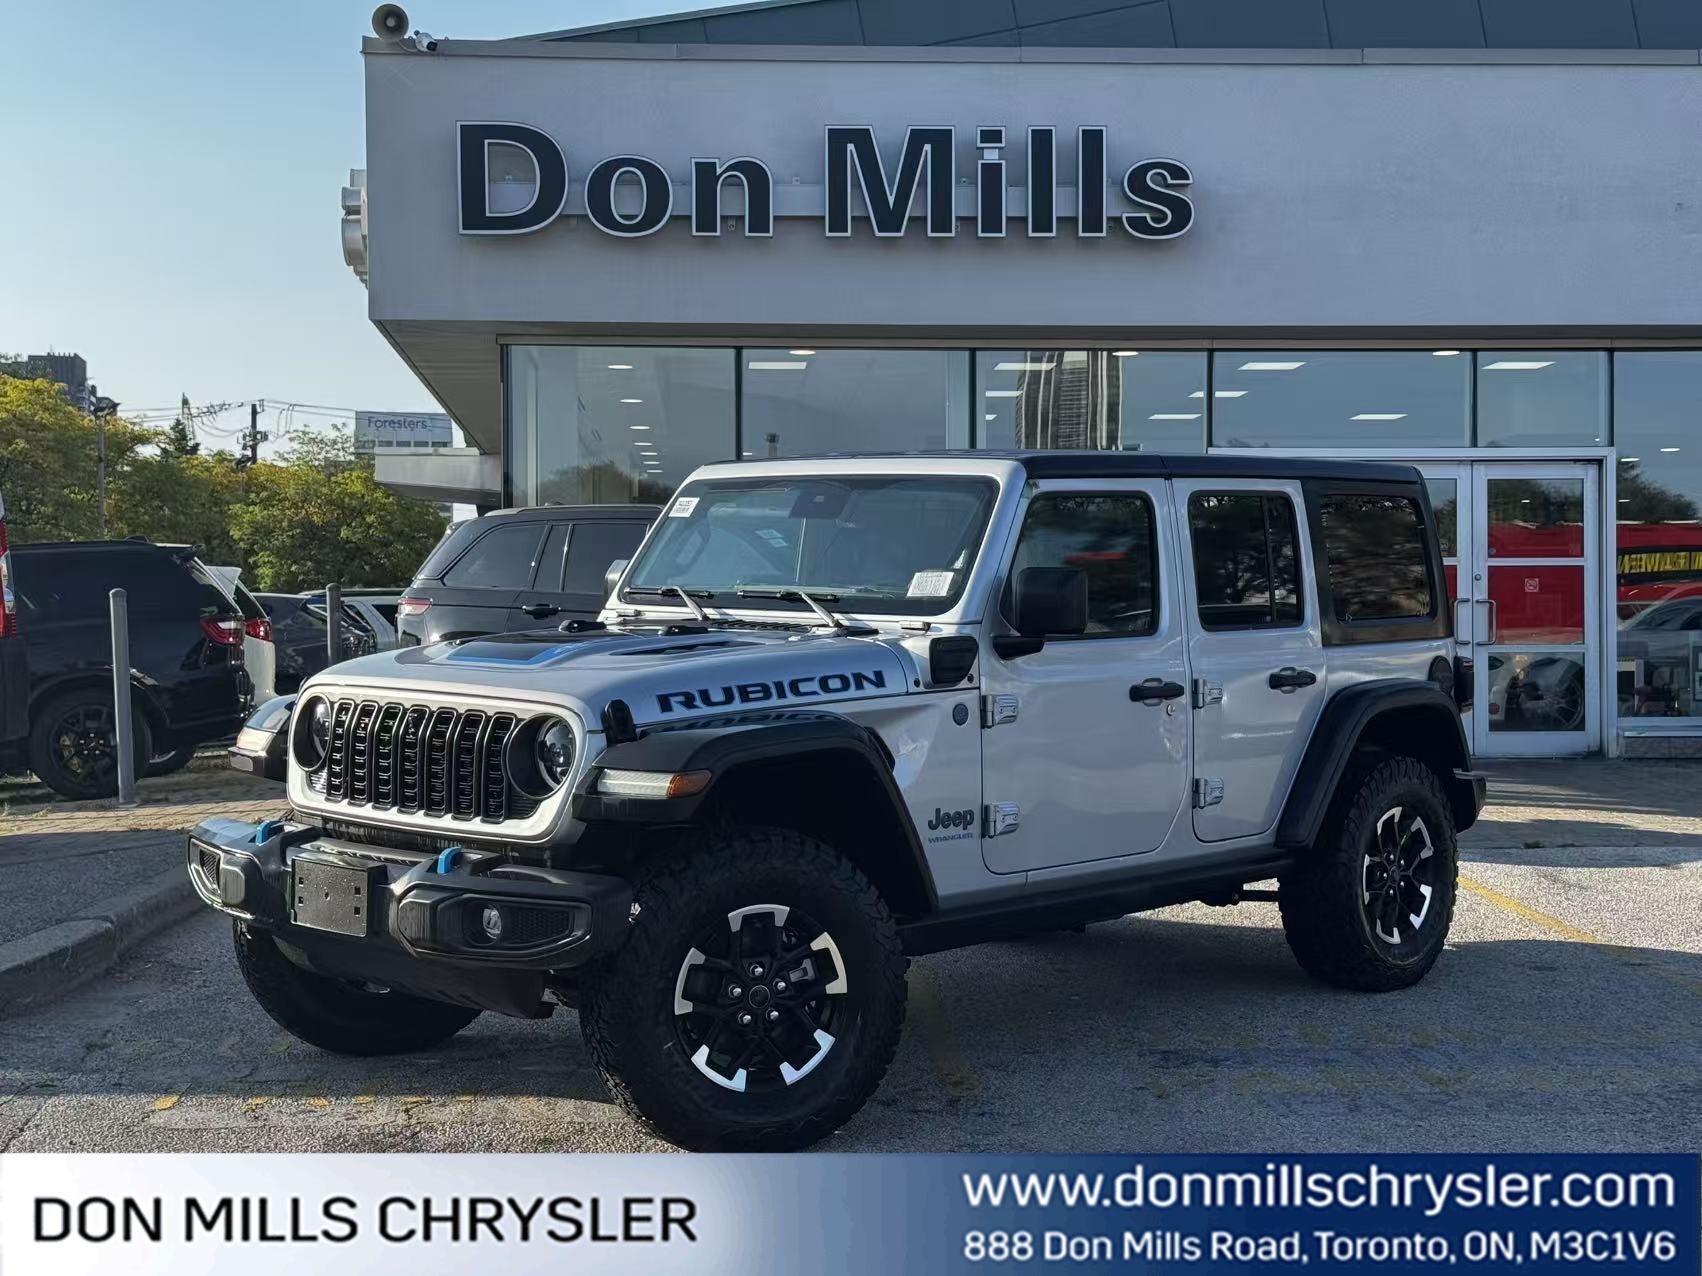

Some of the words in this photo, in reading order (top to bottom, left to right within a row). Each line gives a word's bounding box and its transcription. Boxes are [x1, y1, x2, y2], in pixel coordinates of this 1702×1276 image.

[455, 120, 774, 237] Don
[823, 124, 1195, 240] Mills
[367, 416, 428, 430] Foresters
[656, 670, 887, 712] RUBICON
[928, 807, 975, 831] Jeep
[928, 832, 973, 844] WRANGLER
